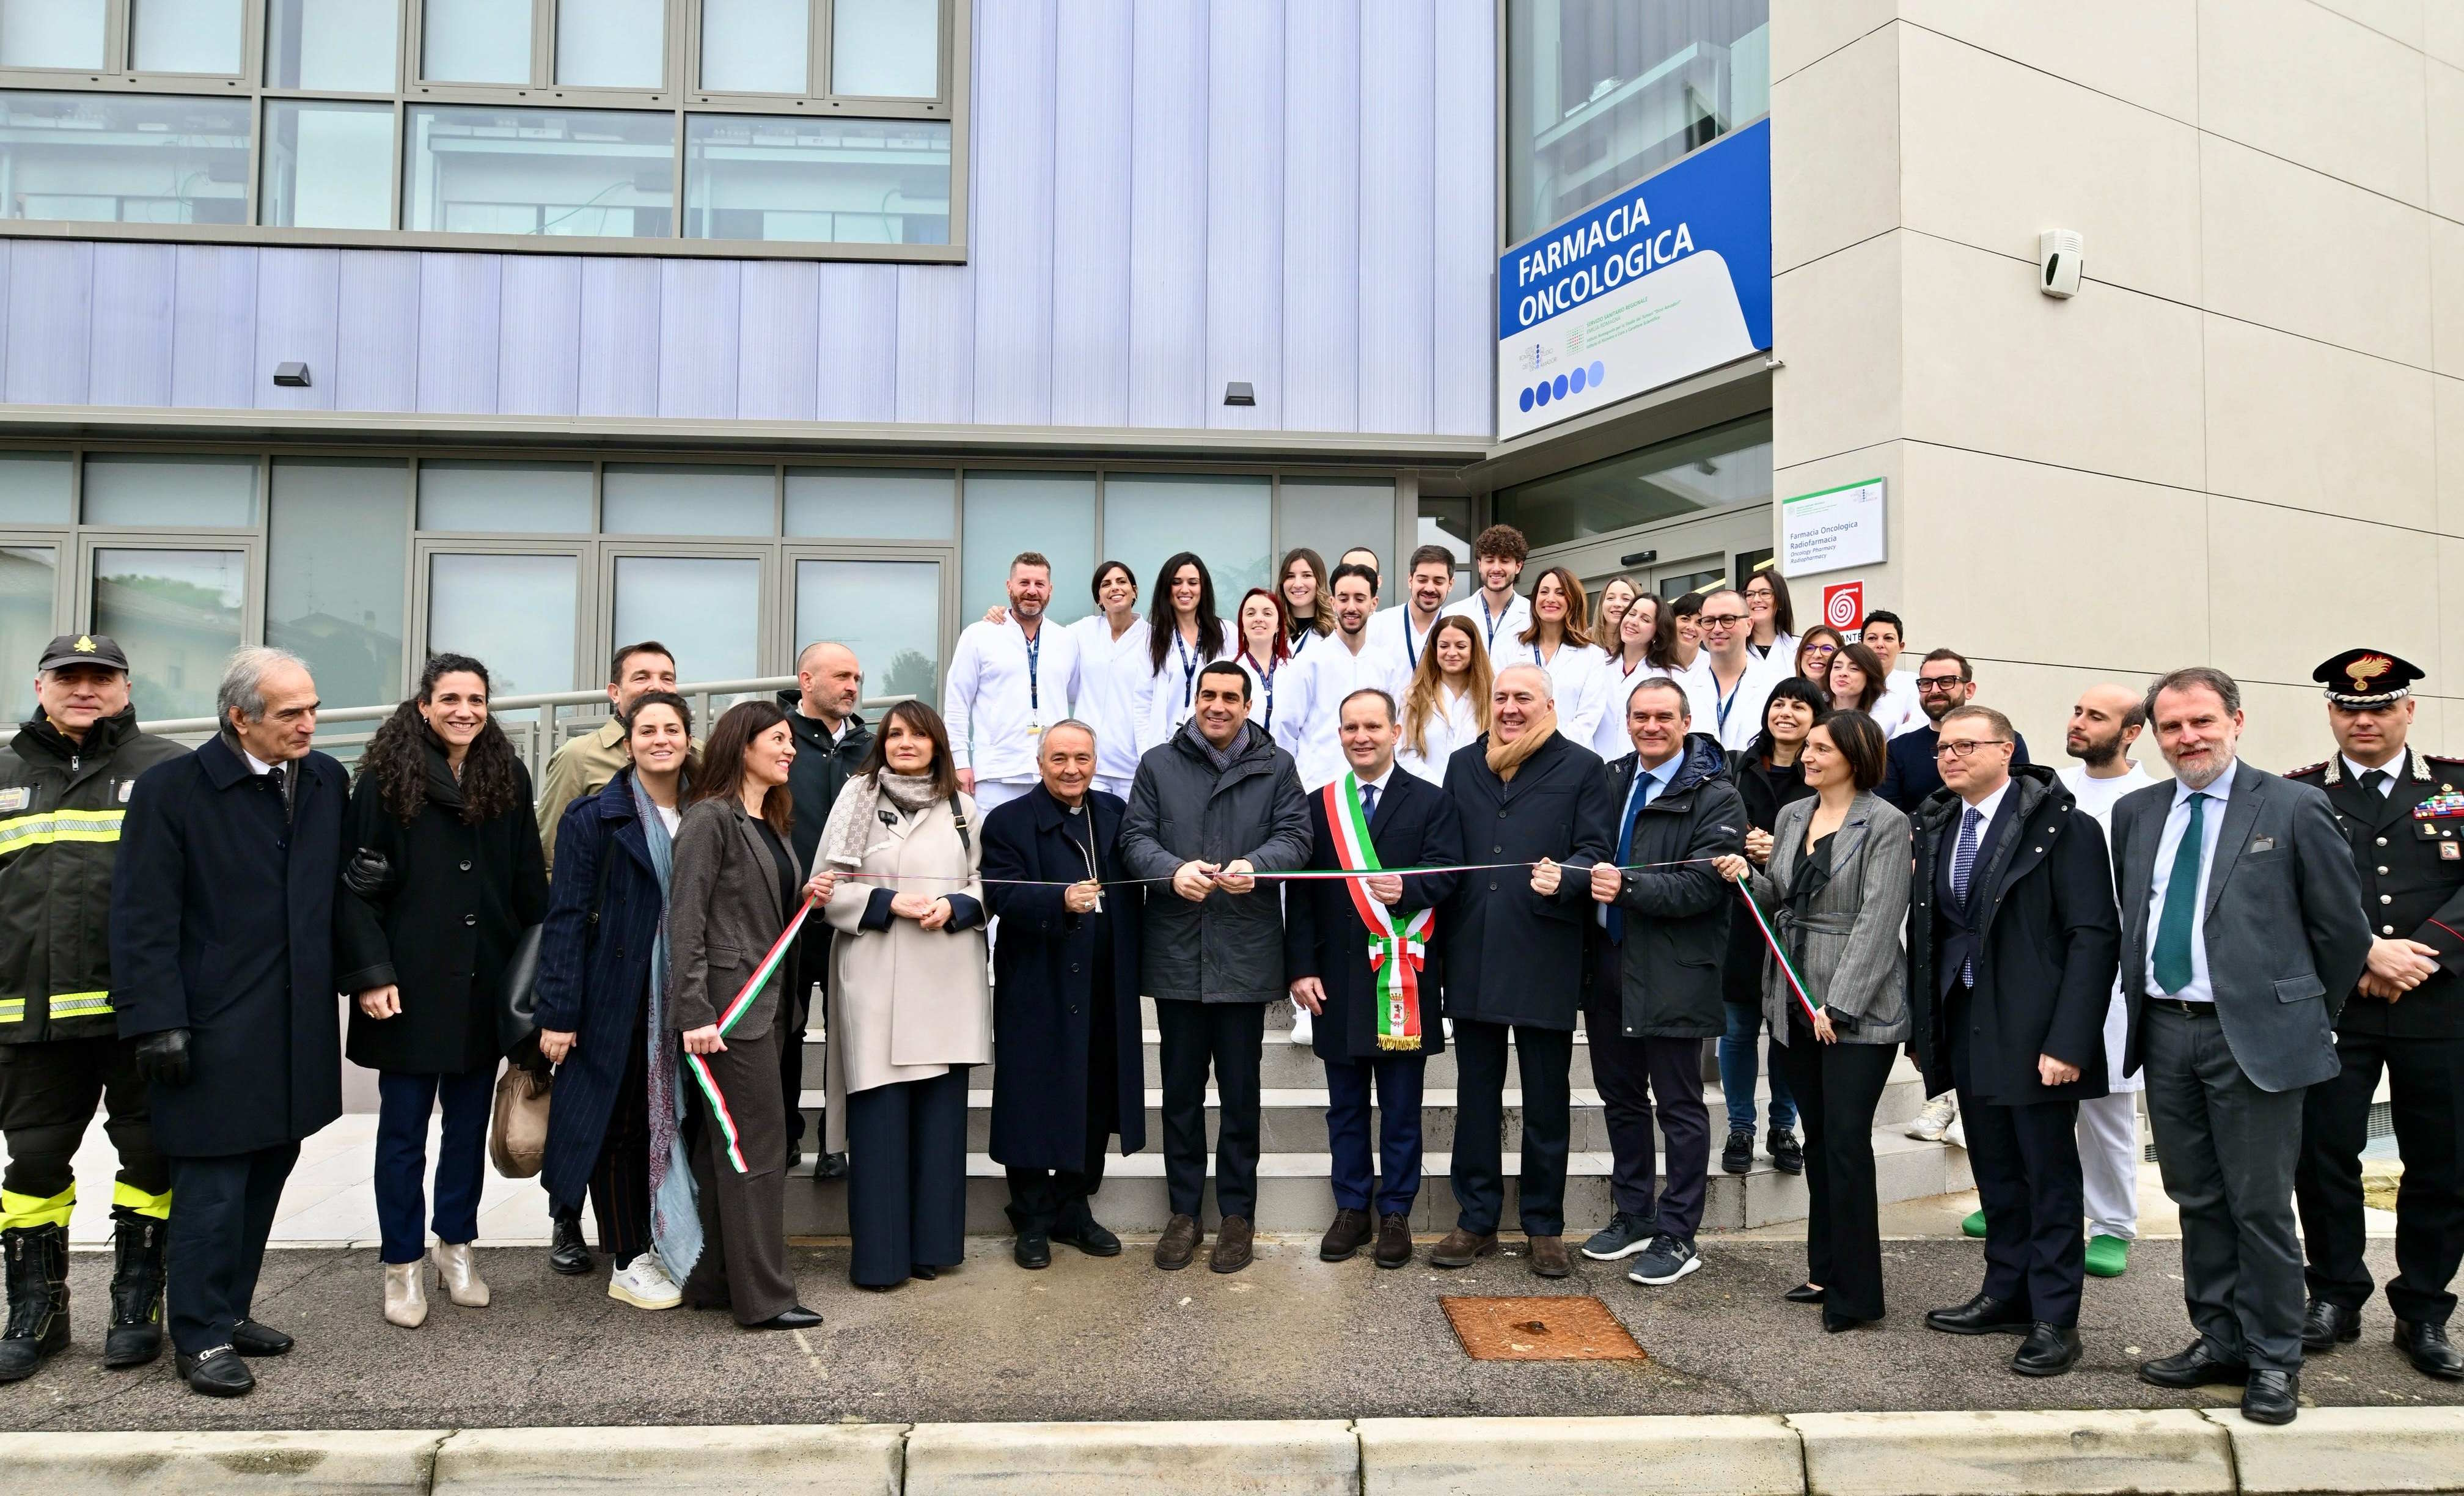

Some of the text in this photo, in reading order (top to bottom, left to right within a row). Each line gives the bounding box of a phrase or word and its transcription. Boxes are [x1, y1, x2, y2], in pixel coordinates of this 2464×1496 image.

[1519, 197, 1651, 287] FARMACIA
[1519, 222, 1695, 326] ONCOLOGICA
[1790, 521, 1858, 540] Farmacia Oncologica
[1790, 535, 1837, 549] Radiofarmacia
[1813, 544, 1836, 553] Pharmacy
[1790, 553, 1827, 563] Radiopharmacy
